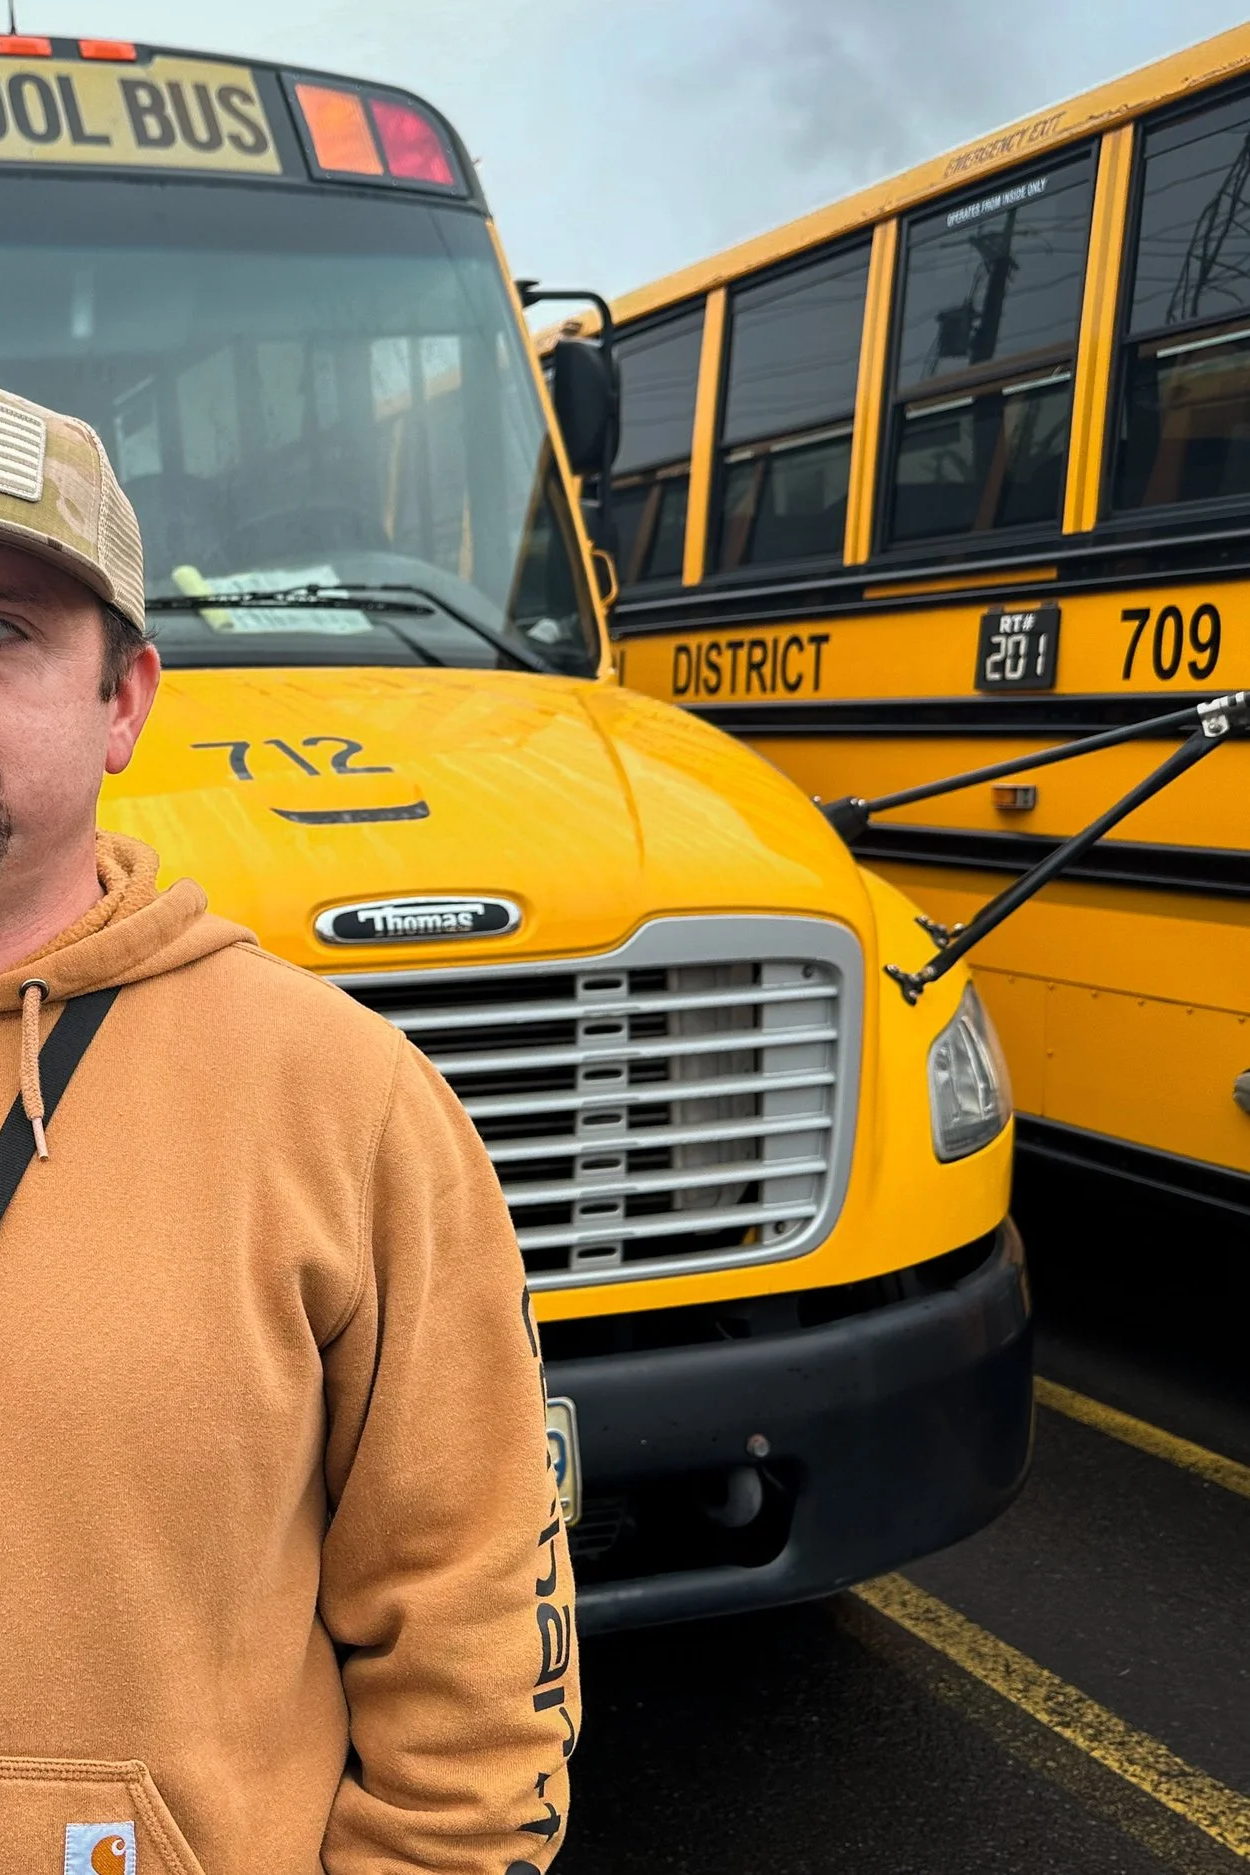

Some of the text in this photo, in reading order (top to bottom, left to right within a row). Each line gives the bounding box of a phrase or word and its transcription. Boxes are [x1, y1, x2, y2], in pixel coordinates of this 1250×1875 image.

[119, 78, 271, 155] BUS
[943, 111, 1067, 178] EMERGENCY EXIT
[946, 176, 1048, 227] OPERATES FROM INSIDE ONLY
[999, 612, 1036, 634] RT#
[1120, 603, 1222, 681] 709
[672, 634, 830, 697] DISTRICT
[985, 632, 1049, 681] 201
[190, 736, 395, 781] 712
[357, 903, 485, 933] Thomas
